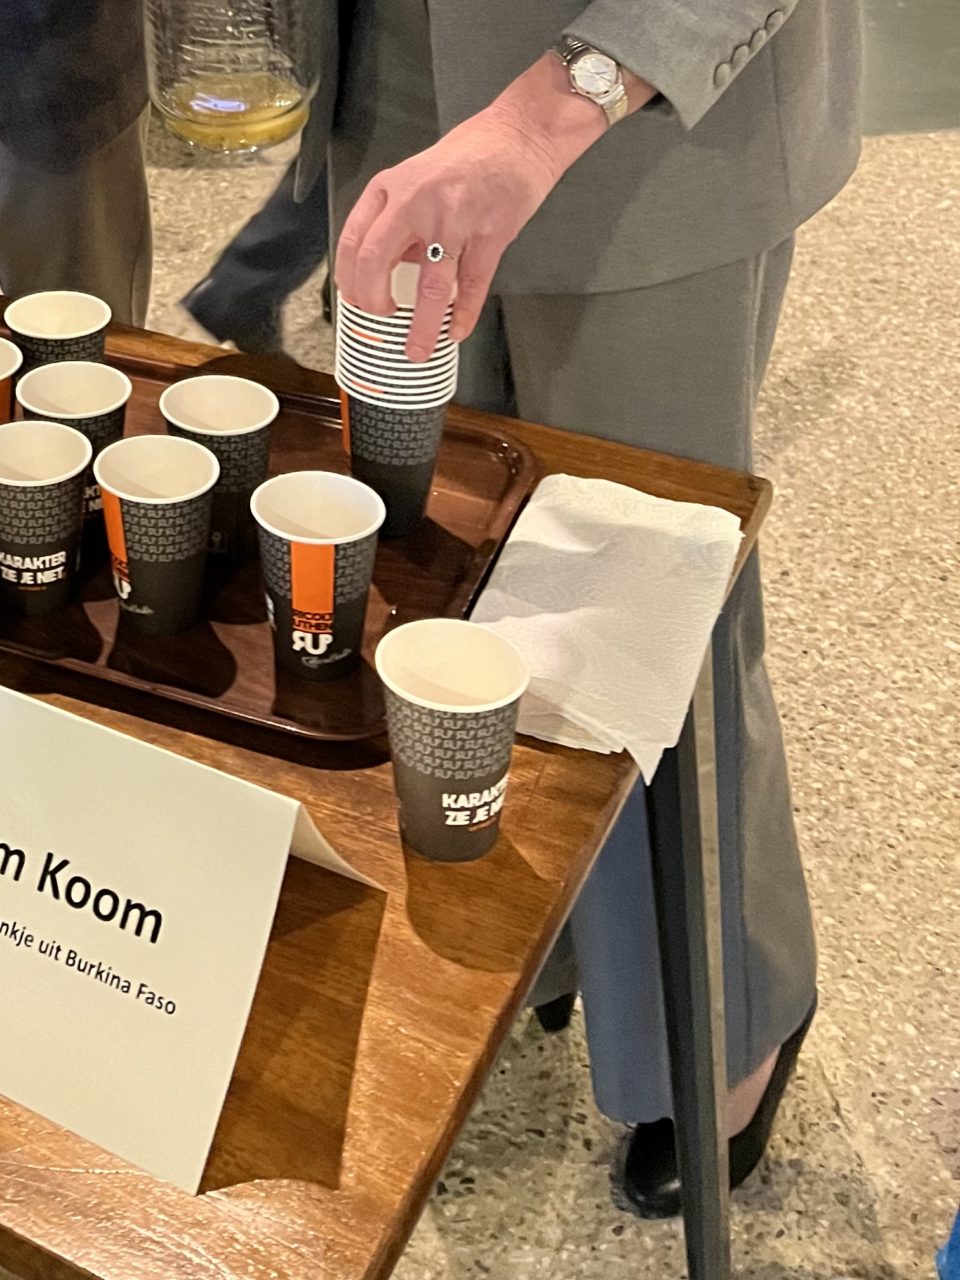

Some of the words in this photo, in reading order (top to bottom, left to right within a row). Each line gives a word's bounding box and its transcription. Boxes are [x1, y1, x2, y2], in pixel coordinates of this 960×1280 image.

[20, 572, 35, 585] JE
[471, 805, 490, 824] JE
[36, 851, 163, 945] Koom
[37, 939, 63, 962] uit
[64, 948, 132, 995] Burkina
[135, 982, 177, 1015] Faso
